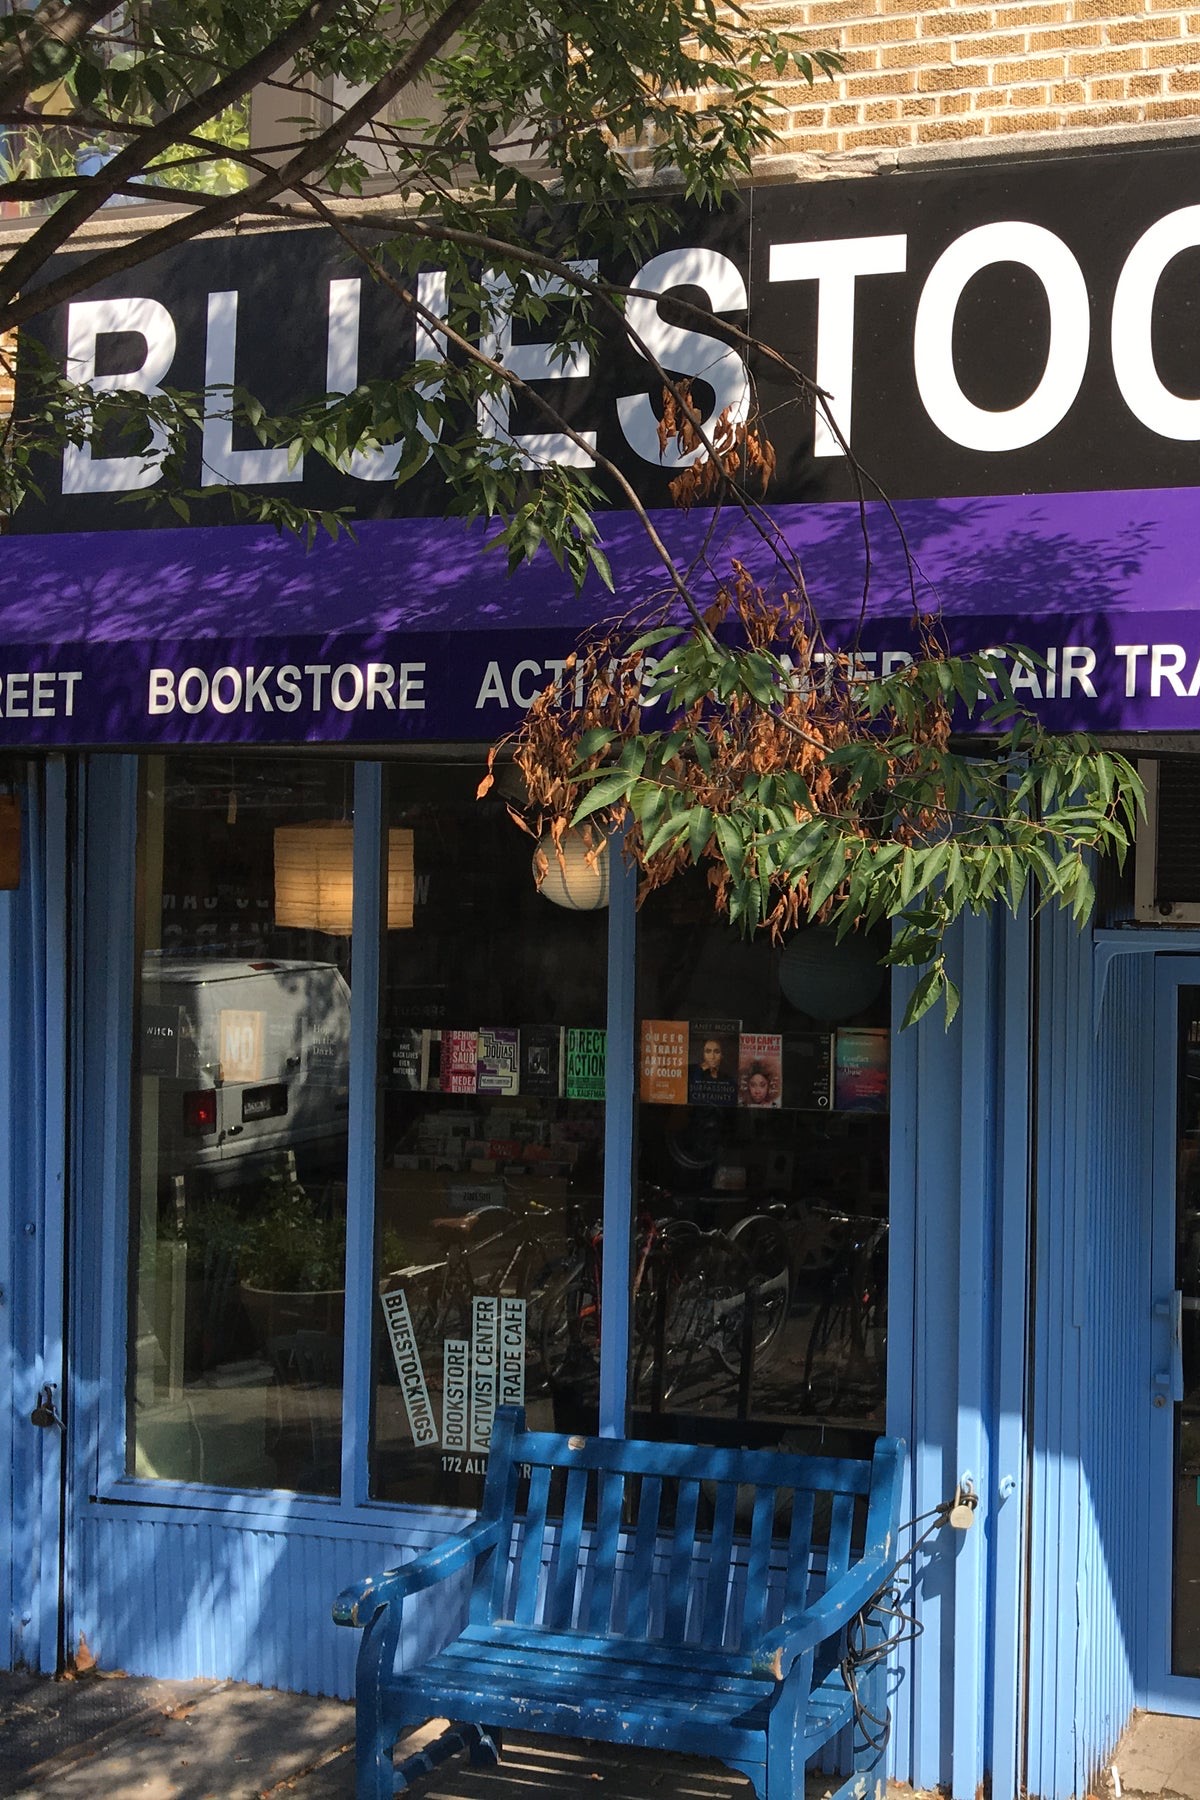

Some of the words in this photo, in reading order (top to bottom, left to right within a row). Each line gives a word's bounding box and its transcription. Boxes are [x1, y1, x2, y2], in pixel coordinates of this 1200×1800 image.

[0, 671, 83, 718] EET
[148, 661, 427, 715] BOOKSTORE
[475, 655, 680, 710] ACTIS
[977, 646, 1098, 700] FAIR
[453, 1051, 478, 1064] SAUDI
[569, 1031, 606, 1053] DIRECT
[645, 1033, 684, 1043] QUEER
[653, 1045, 684, 1054] TRANS
[740, 1035, 756, 1044] YOU
[568, 1054, 606, 1076] ACTION
[645, 1056, 683, 1066] ARTISTS
[656, 1068, 682, 1078] COLOR
[476, 1301, 494, 1368] CENTER
[504, 1302, 523, 1345] CAFE
[385, 1294, 433, 1443] BLUESTOCKINGS
[503, 1351, 521, 1406] TRADE
[446, 1343, 465, 1447] BOOKSTORE
[473, 1371, 493, 1449] ACTIVIST
[441, 1456, 462, 1473] 172
[465, 1458, 487, 1476] ALL
